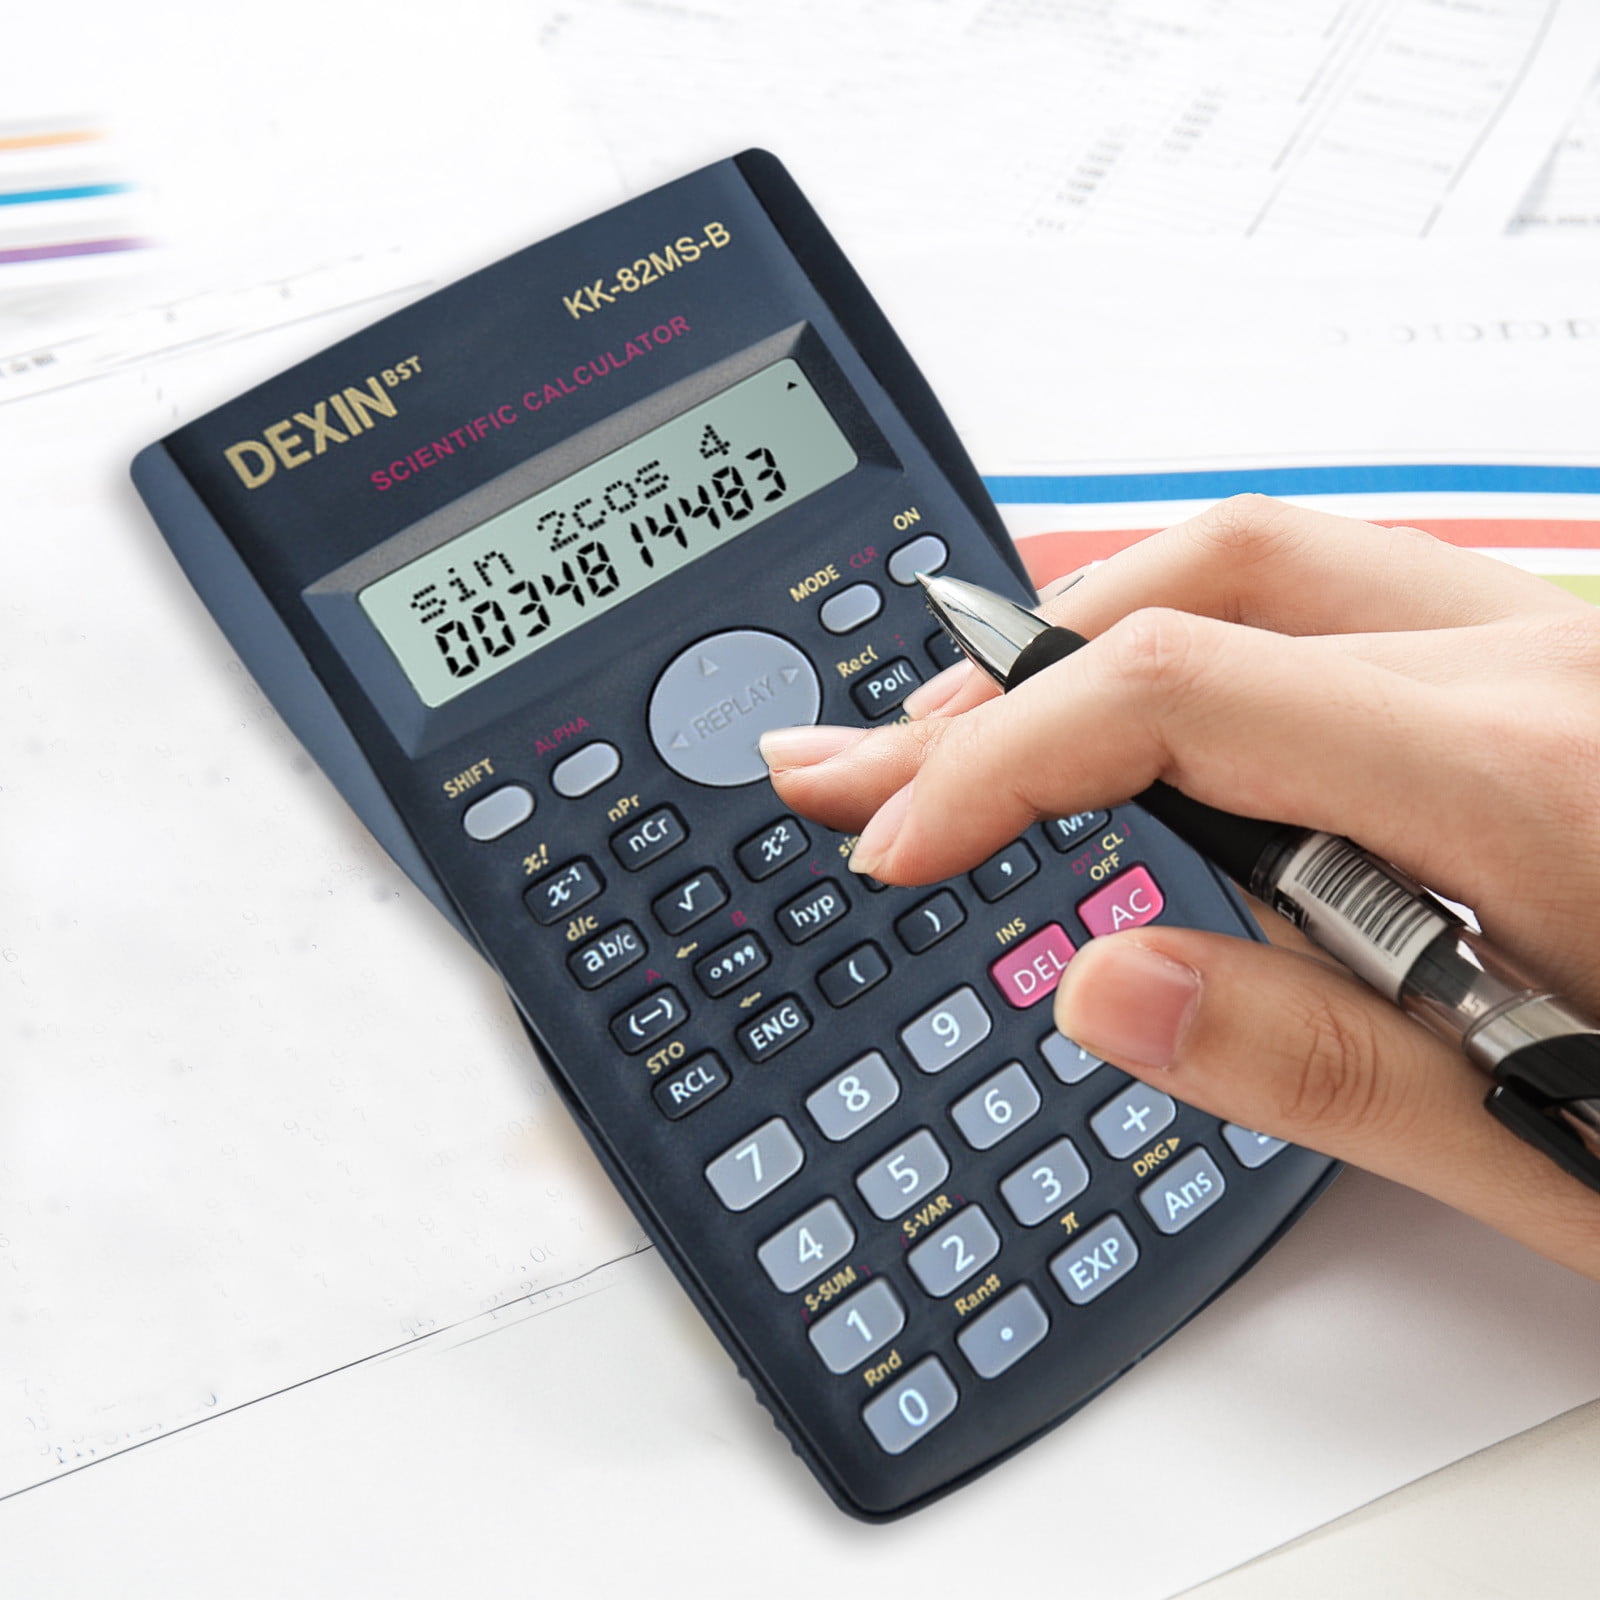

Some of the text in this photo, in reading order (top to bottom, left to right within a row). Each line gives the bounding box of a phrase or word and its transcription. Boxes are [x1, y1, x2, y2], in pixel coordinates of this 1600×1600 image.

[563, 222, 731, 319] KK-82MS-B
[224, 356, 422, 489] DEXIN BST
[369, 315, 691, 492] SCIENTIFIC CALCULATOR
[410, 550, 515, 624] sin
[699, 424, 731, 459] 4
[892, 507, 921, 531] ON
[849, 546, 879, 569] CLR
[789, 564, 841, 602] MODE
[693, 672, 776, 740] REPLAY
[535, 716, 590, 756] ALPHA
[443, 759, 494, 798] SHIFT
[607, 795, 640, 822] nPr
[629, 818, 668, 852] nCr
[1090, 852, 1120, 880] OFF
[567, 915, 599, 941] d/c
[790, 895, 835, 927] hyp
[1111, 887, 1152, 931] AC
[996, 917, 1026, 944] INS
[1012, 949, 1069, 996] DEL
[749, 1006, 800, 1050] ENG
[931, 1012, 960, 1047] 9
[646, 1041, 685, 1075] STO
[669, 1066, 716, 1104] RCL
[838, 1076, 871, 1112] 8
[984, 1088, 1012, 1124] 6
[735, 1143, 763, 1182] 7
[887, 1154, 919, 1194] 5
[1032, 1167, 1061, 1203] 3
[1165, 1172, 1212, 1220] Ans
[902, 1194, 953, 1238] S-VAR
[799, 1227, 823, 1263] 4
[941, 1235, 975, 1272] 2
[1069, 1238, 1119, 1290] EXP
[804, 1265, 857, 1311] S-SUM
[847, 1309, 872, 1341] 1
[863, 1349, 903, 1387] Rnd
[898, 1388, 930, 1426] 0
